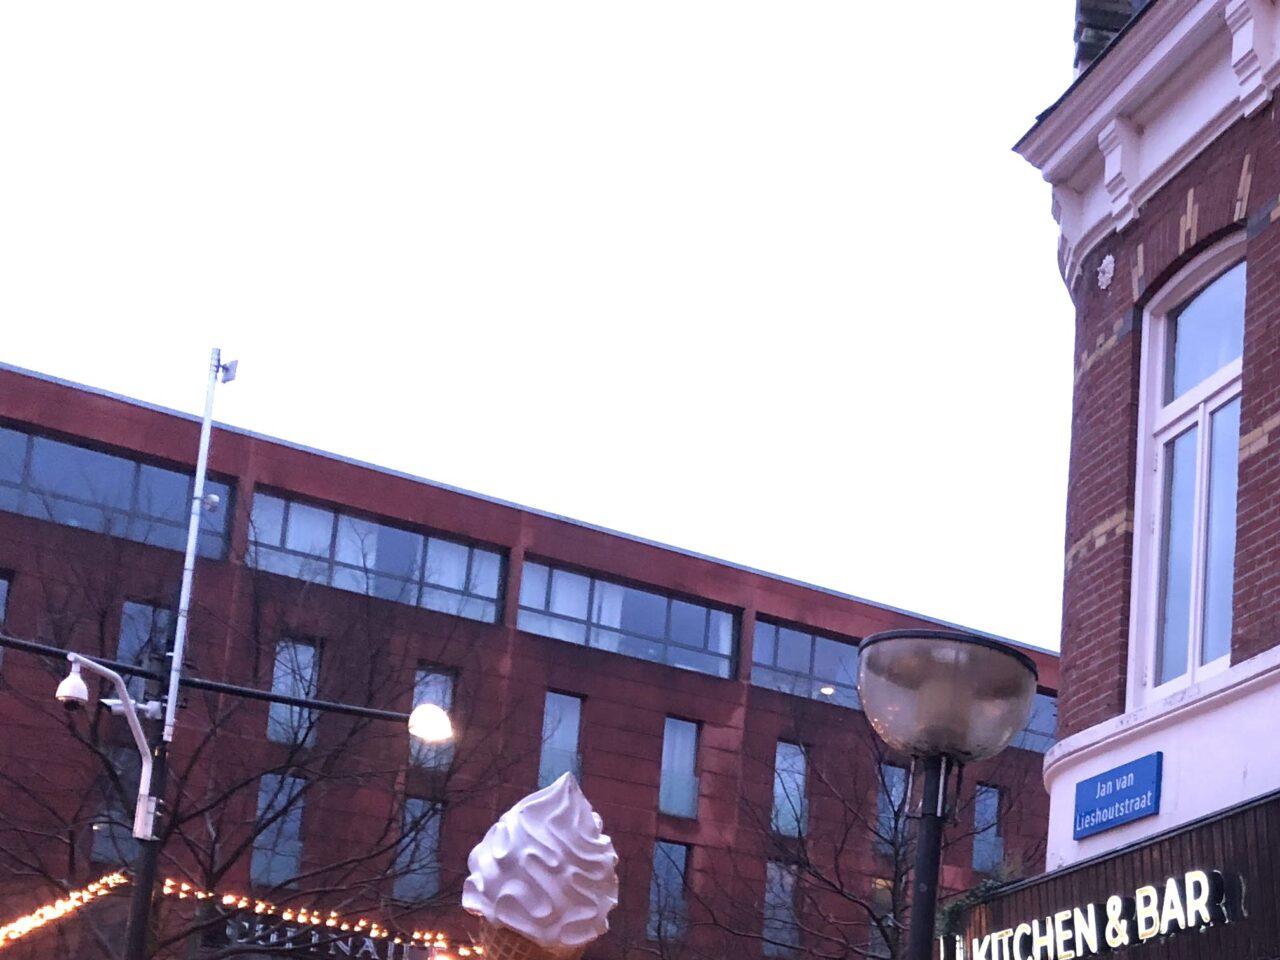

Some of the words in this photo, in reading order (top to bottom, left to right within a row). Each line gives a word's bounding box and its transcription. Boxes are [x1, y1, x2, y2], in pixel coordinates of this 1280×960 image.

[1095, 781, 1113, 799] Jan
[1115, 772, 1134, 791] van
[1076, 790, 1153, 831] Lieshoutstraat
[1105, 894, 1130, 949] &
[1135, 870, 1211, 941] BAR
